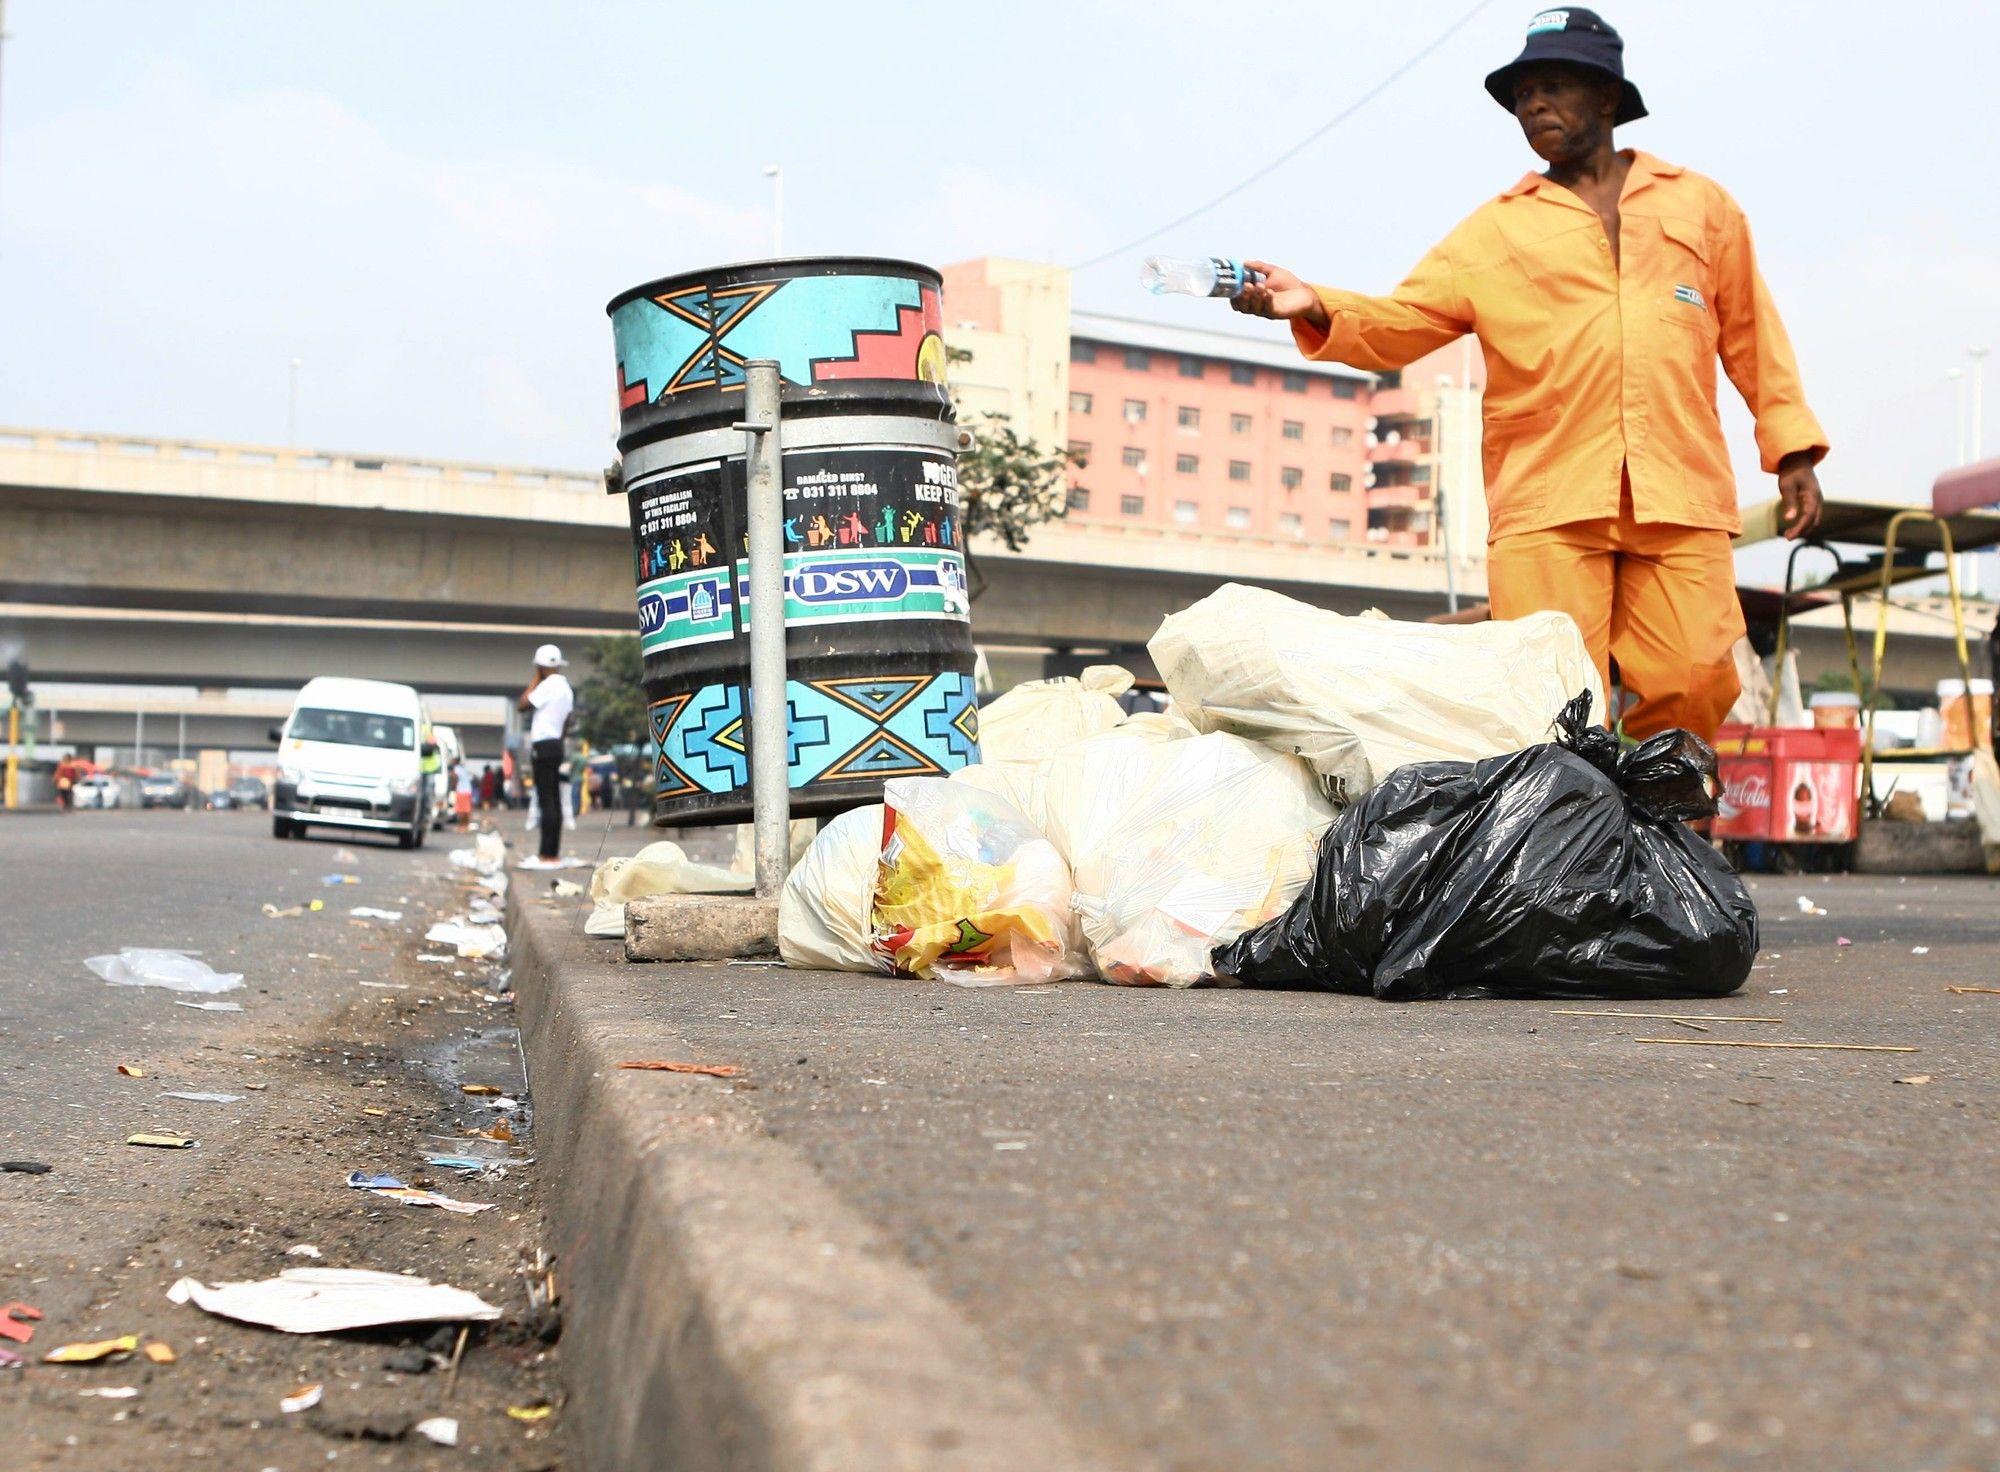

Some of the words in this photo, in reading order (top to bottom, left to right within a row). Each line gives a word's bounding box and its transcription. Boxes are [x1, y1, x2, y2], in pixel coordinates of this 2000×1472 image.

[796, 473, 839, 485] DAMAGED
[839, 472, 865, 482] BINS?
[802, 485, 825, 498] 031
[827, 484, 847, 497] 311
[850, 483, 878, 496] 8804
[914, 483, 942, 502] KEEP
[662, 500, 690, 515] FACILITY
[647, 519, 660, 533] 031
[660, 516, 673, 530] 311
[675, 511, 697, 527] 8804
[796, 568, 899, 597] DSW
